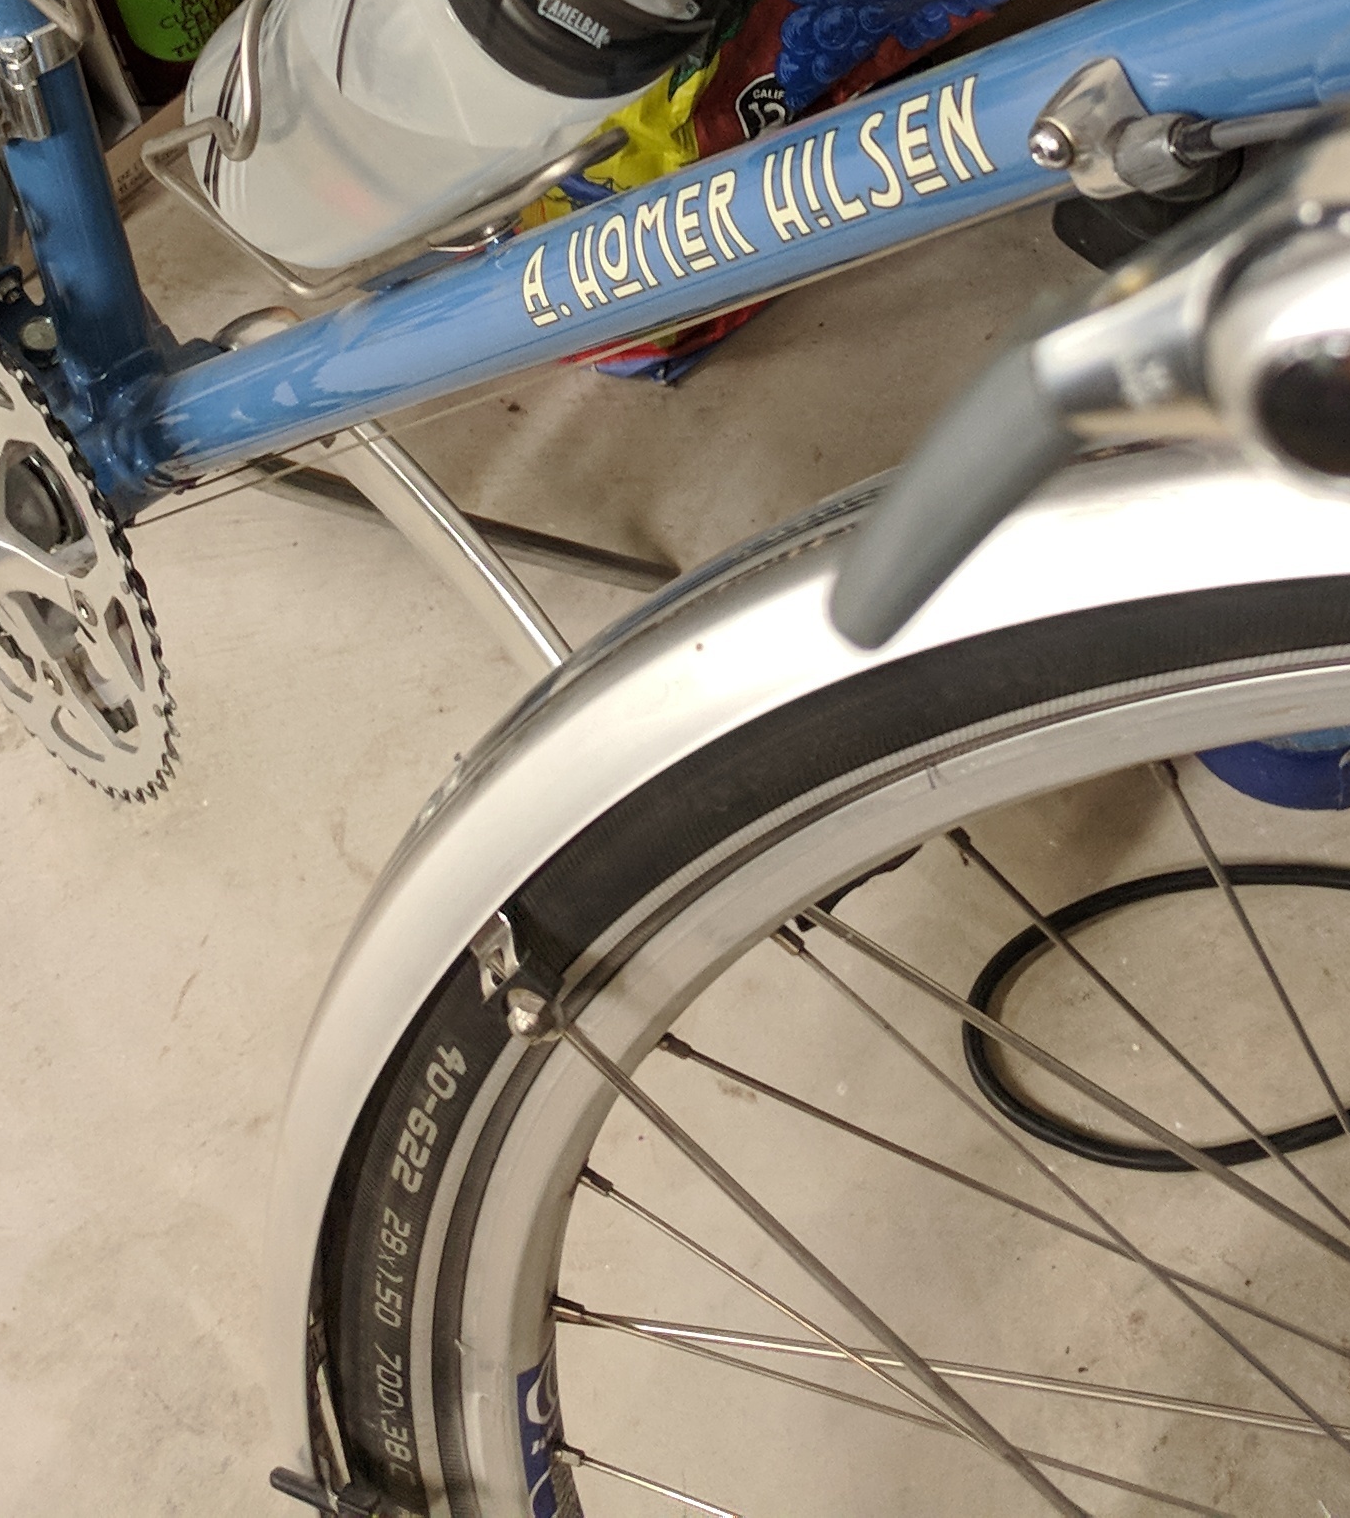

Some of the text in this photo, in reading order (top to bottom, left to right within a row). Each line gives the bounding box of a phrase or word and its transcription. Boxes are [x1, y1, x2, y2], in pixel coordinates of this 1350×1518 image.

[567, 170, 760, 314] HOMER
[762, 72, 998, 243] HILSEN
[390, 1044, 468, 1194] 40-622
